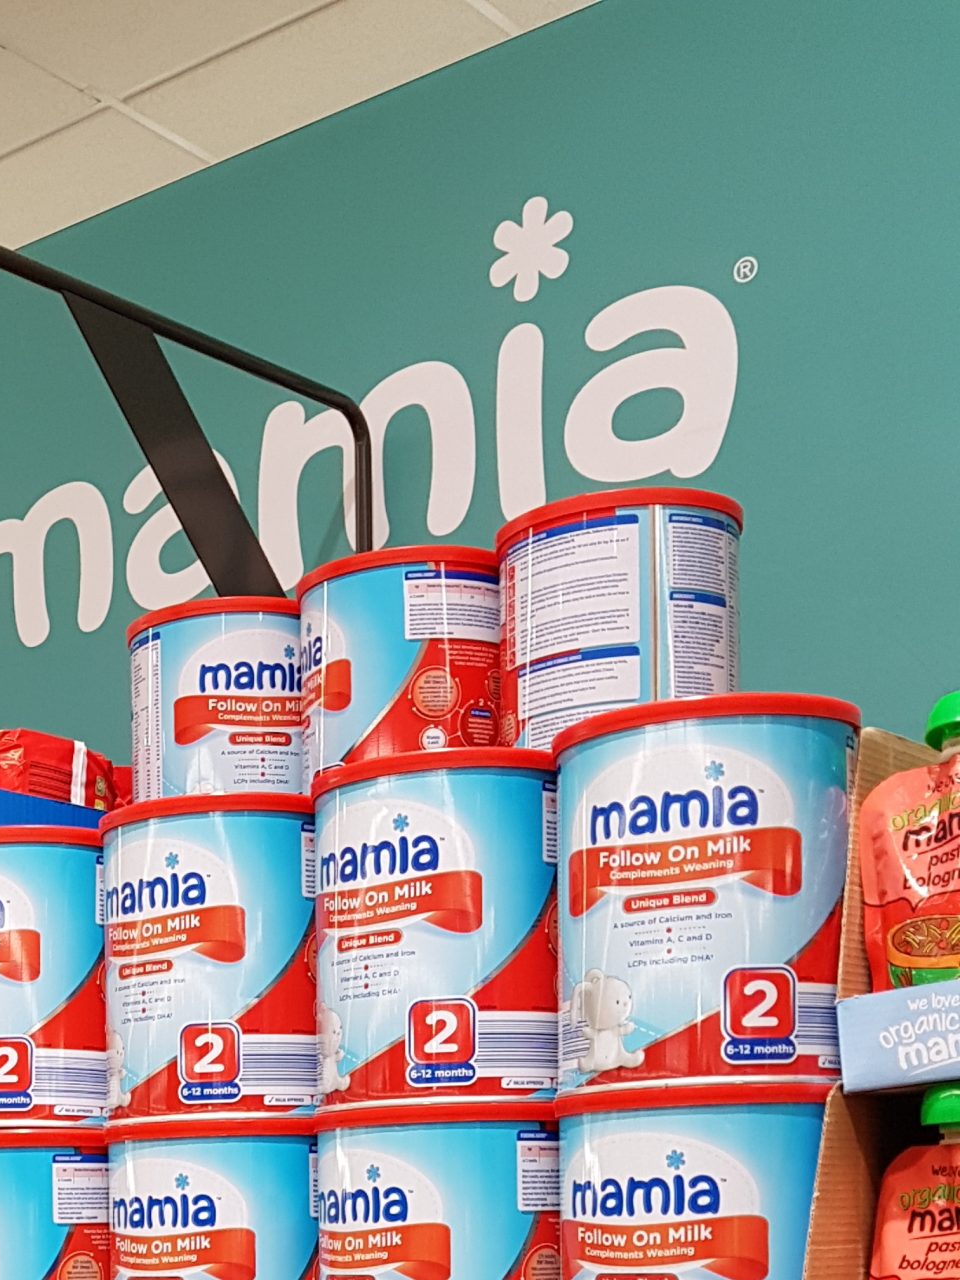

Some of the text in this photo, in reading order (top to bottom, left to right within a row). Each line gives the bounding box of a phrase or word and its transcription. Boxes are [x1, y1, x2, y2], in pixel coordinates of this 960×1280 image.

[591, 760, 758, 845] mamia
[599, 836, 750, 868] Follow On Milk
[609, 858, 733, 880] Complements Weaning
[324, 882, 432, 911] Follow On Milk
[109, 914, 200, 939] Follow On Milk
[742, 979, 778, 1027] 2
[424, 1010, 458, 1053] 2
[880, 1008, 959, 1048] organic
[193, 1034, 225, 1072] 2
[727, 1043, 793, 1053] 6-12 months
[572, 1150, 720, 1219] mamia
[116, 1236, 210, 1253] Follow On Milk
[577, 1226, 712, 1246] Follow On Milk
